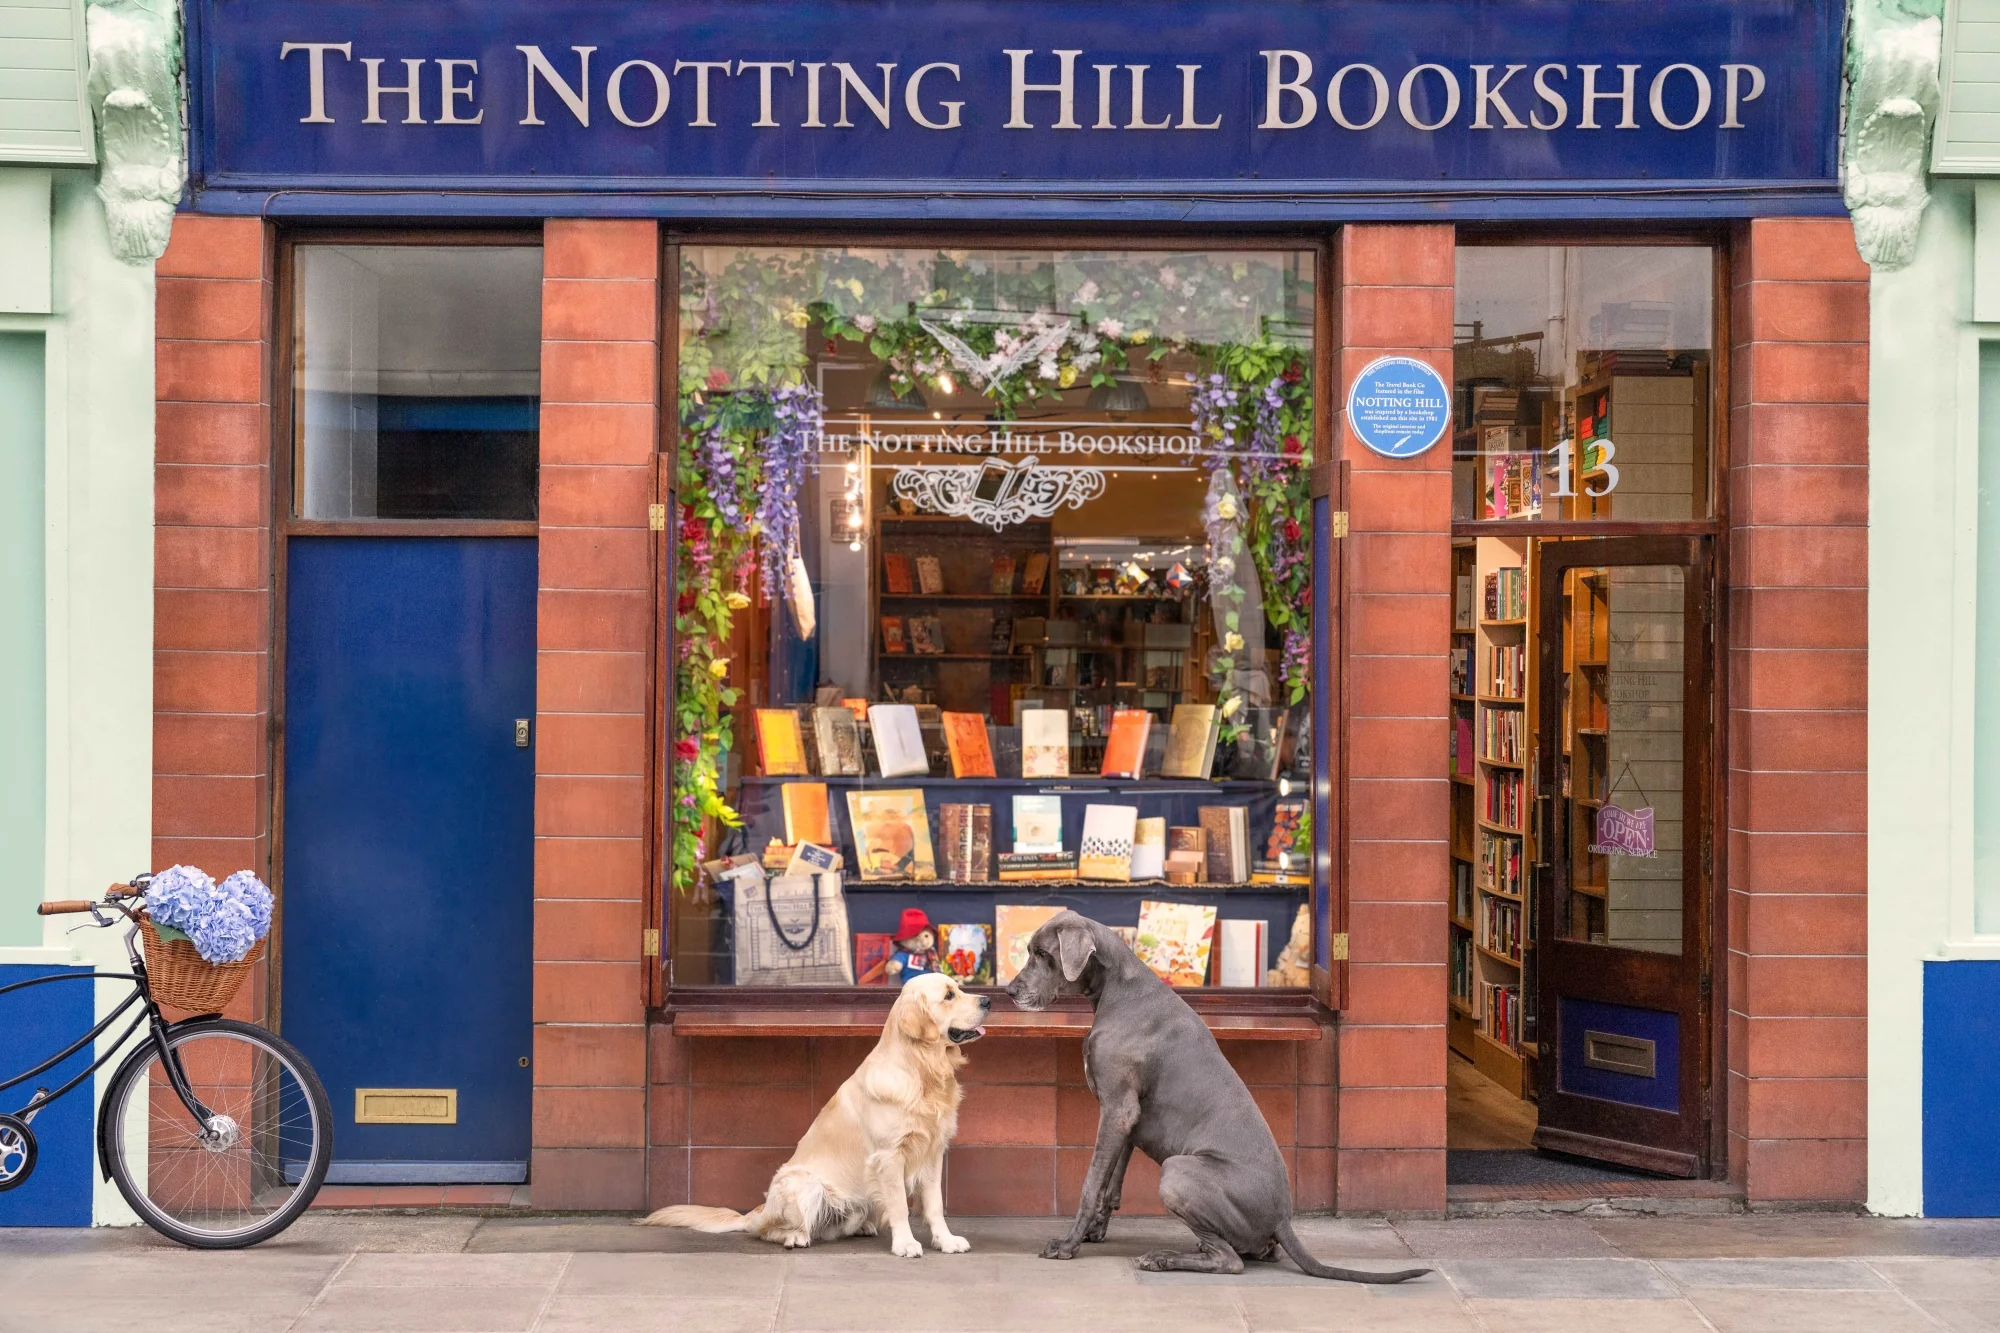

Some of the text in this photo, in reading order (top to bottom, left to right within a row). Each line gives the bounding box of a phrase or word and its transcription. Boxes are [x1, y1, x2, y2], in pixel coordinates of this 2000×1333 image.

[280, 41, 1766, 130] THE NOTTING HILL BOOKSHOP
[1356, 397, 1443, 408] NOTTING HILL
[796, 430, 1201, 454] THE NOTTING HILL BOOKSHOP
[1548, 438, 1620, 497] 13
[1637, 674, 1657, 686] HILL
[1602, 818, 1648, 849] OPEN
[1627, 818, 1634, 828] WE
[1636, 821, 1647, 830] ARE
[1588, 844, 1658, 859] ORDERING SERVICE
